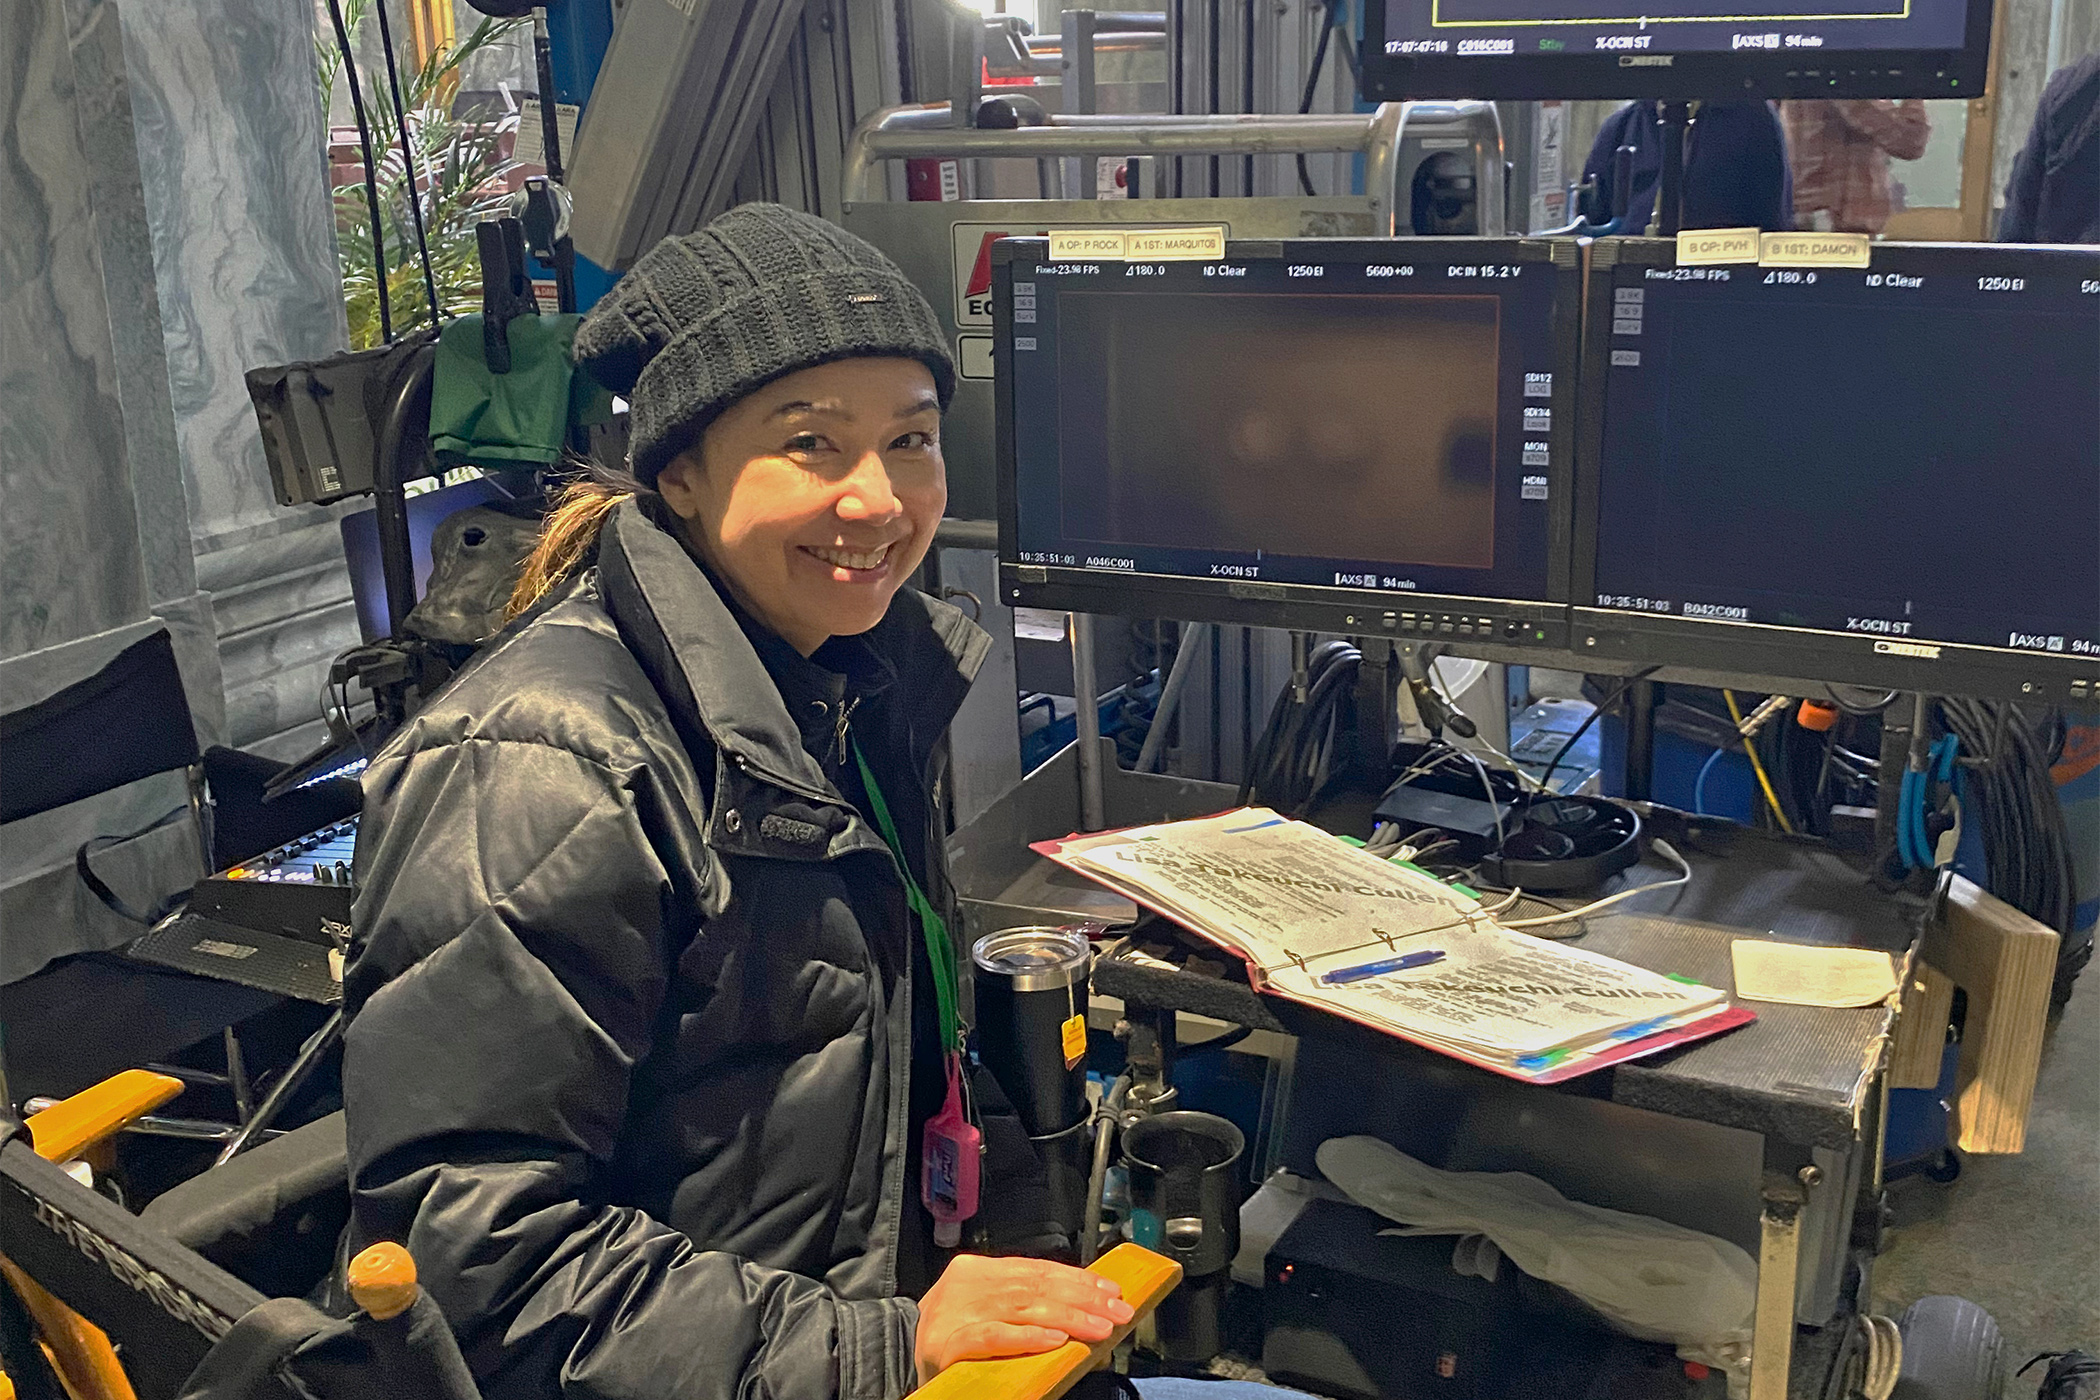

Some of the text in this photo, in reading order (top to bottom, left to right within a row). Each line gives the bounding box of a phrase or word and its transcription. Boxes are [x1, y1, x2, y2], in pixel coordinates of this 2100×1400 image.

[1058, 240, 1119, 250] A OP: P ROCK
[1135, 239, 1142, 250] A
[1165, 238, 1217, 250] MARQUITOS
[1690, 242, 1698, 253] B
[1772, 243, 1780, 254] B
[1811, 244, 1858, 256] DAMON
[1083, 264, 1100, 275] FPS
[1203, 265, 1215, 276] ND
[1218, 264, 1247, 276] Clear
[1480, 265, 1509, 278] 15.2
[1511, 265, 1521, 277] V
[1885, 274, 1924, 288] Clear
[2081, 279, 2100, 294] 56
[1528, 385, 1547, 394] LOG
[1524, 442, 1548, 452] MON
[1523, 476, 1547, 485] HDMI
[1019, 551, 1075, 565] 10:35:51:03
[1086, 556, 1135, 570] A046C001
[1210, 563, 1243, 577] X-OCN
[1245, 566, 1259, 578] ST
[1340, 573, 1363, 586] AXS
[1598, 594, 1670, 612] 10:35:51:03
[1683, 602, 1748, 620] B042C001
[1846, 616, 1889, 633] X-OCN
[1892, 620, 1912, 635] ST
[2017, 634, 2046, 648] AXS
[1115, 851, 1458, 908] Lisa Takeuchi Cullen
[1390, 978, 1562, 996] Takeuchi
[1573, 986, 1688, 1002] Cullen
